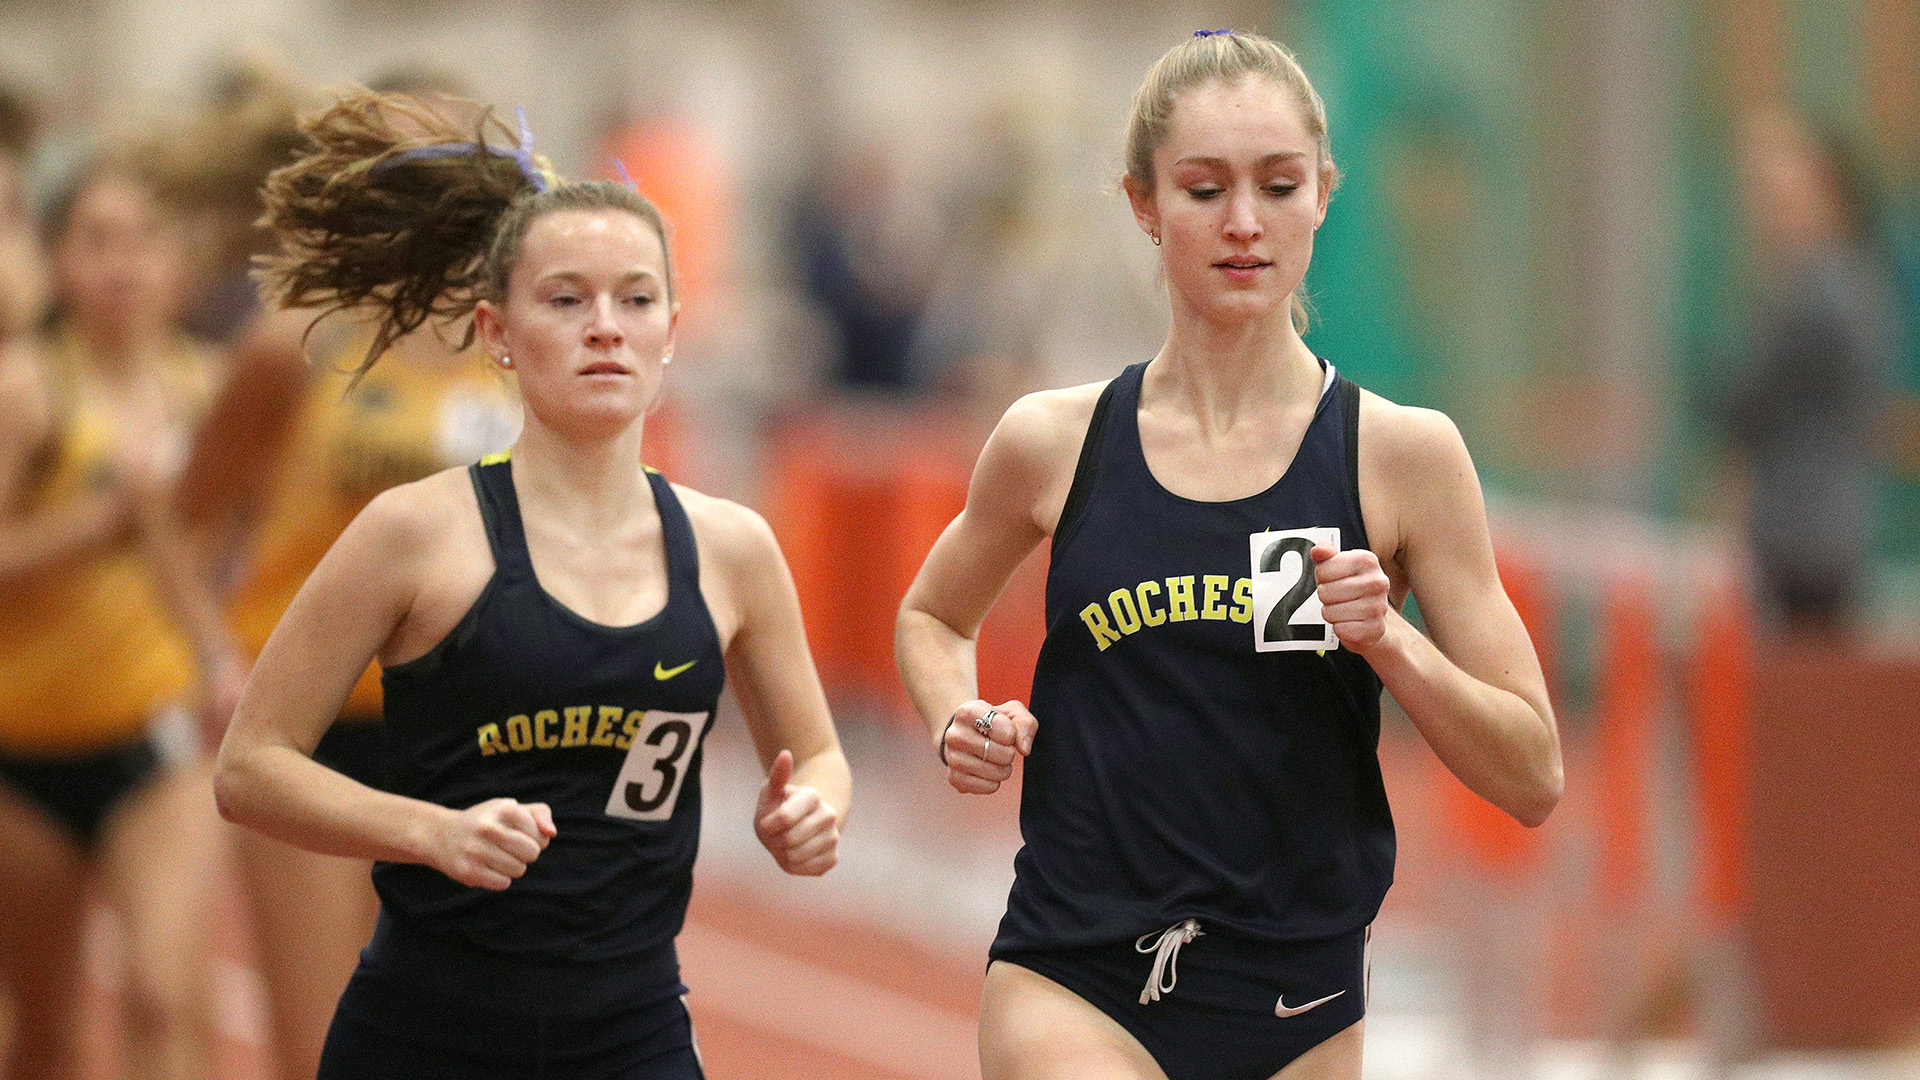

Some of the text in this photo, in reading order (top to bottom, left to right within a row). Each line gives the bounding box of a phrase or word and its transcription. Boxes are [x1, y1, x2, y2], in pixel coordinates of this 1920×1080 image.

[1079, 574, 1253, 652] ROCHES
[1260, 537, 1326, 642] 2
[477, 705, 646, 756] ROCHES
[624, 720, 692, 812] 3
